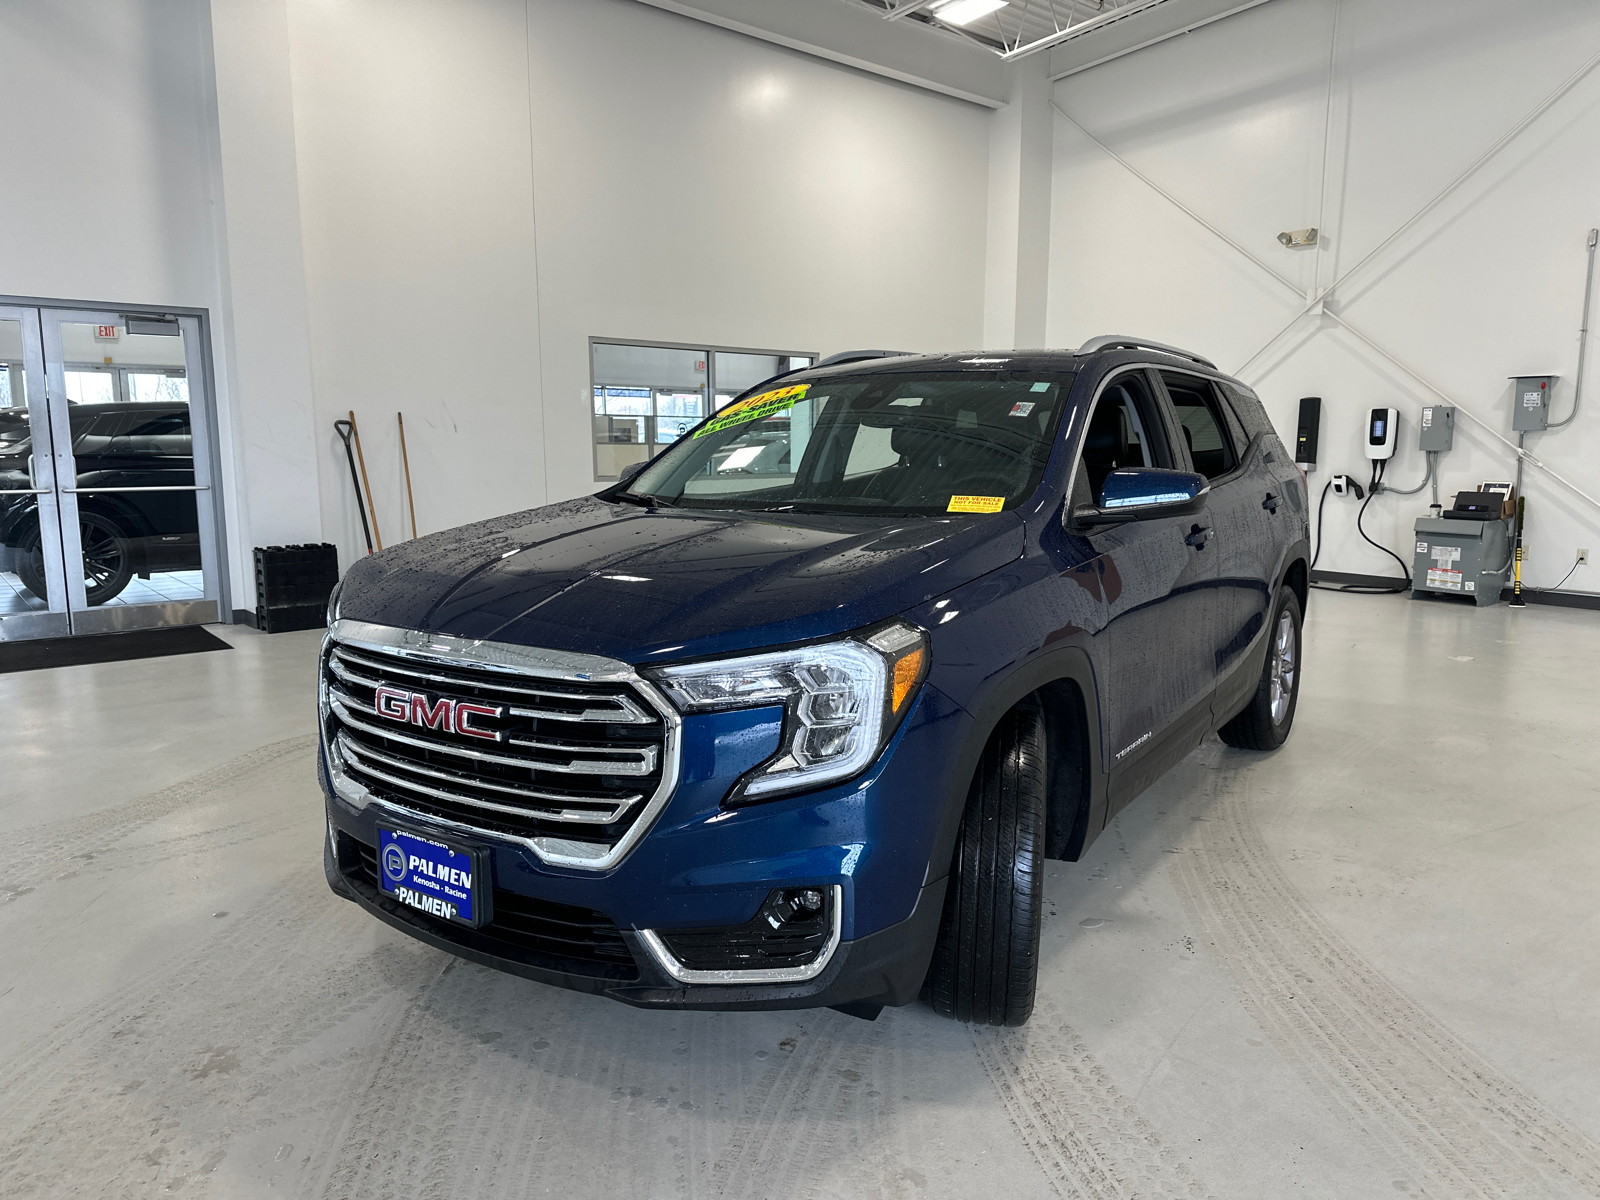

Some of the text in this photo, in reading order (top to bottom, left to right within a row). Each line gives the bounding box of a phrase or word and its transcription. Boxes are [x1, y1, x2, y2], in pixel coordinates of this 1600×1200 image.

[99, 325, 115, 337] EXIT
[697, 426, 717, 437] ALL
[719, 413, 756, 428] WHEEL
[375, 686, 502, 742] GMC
[1115, 731, 1152, 760] TERRAIN
[396, 830, 449, 850] palmen.com
[409, 855, 472, 889] PALMEN
[413, 875, 440, 891] Kenosha
[444, 886, 467, 900] Racine
[399, 887, 451, 920] PALMEN
